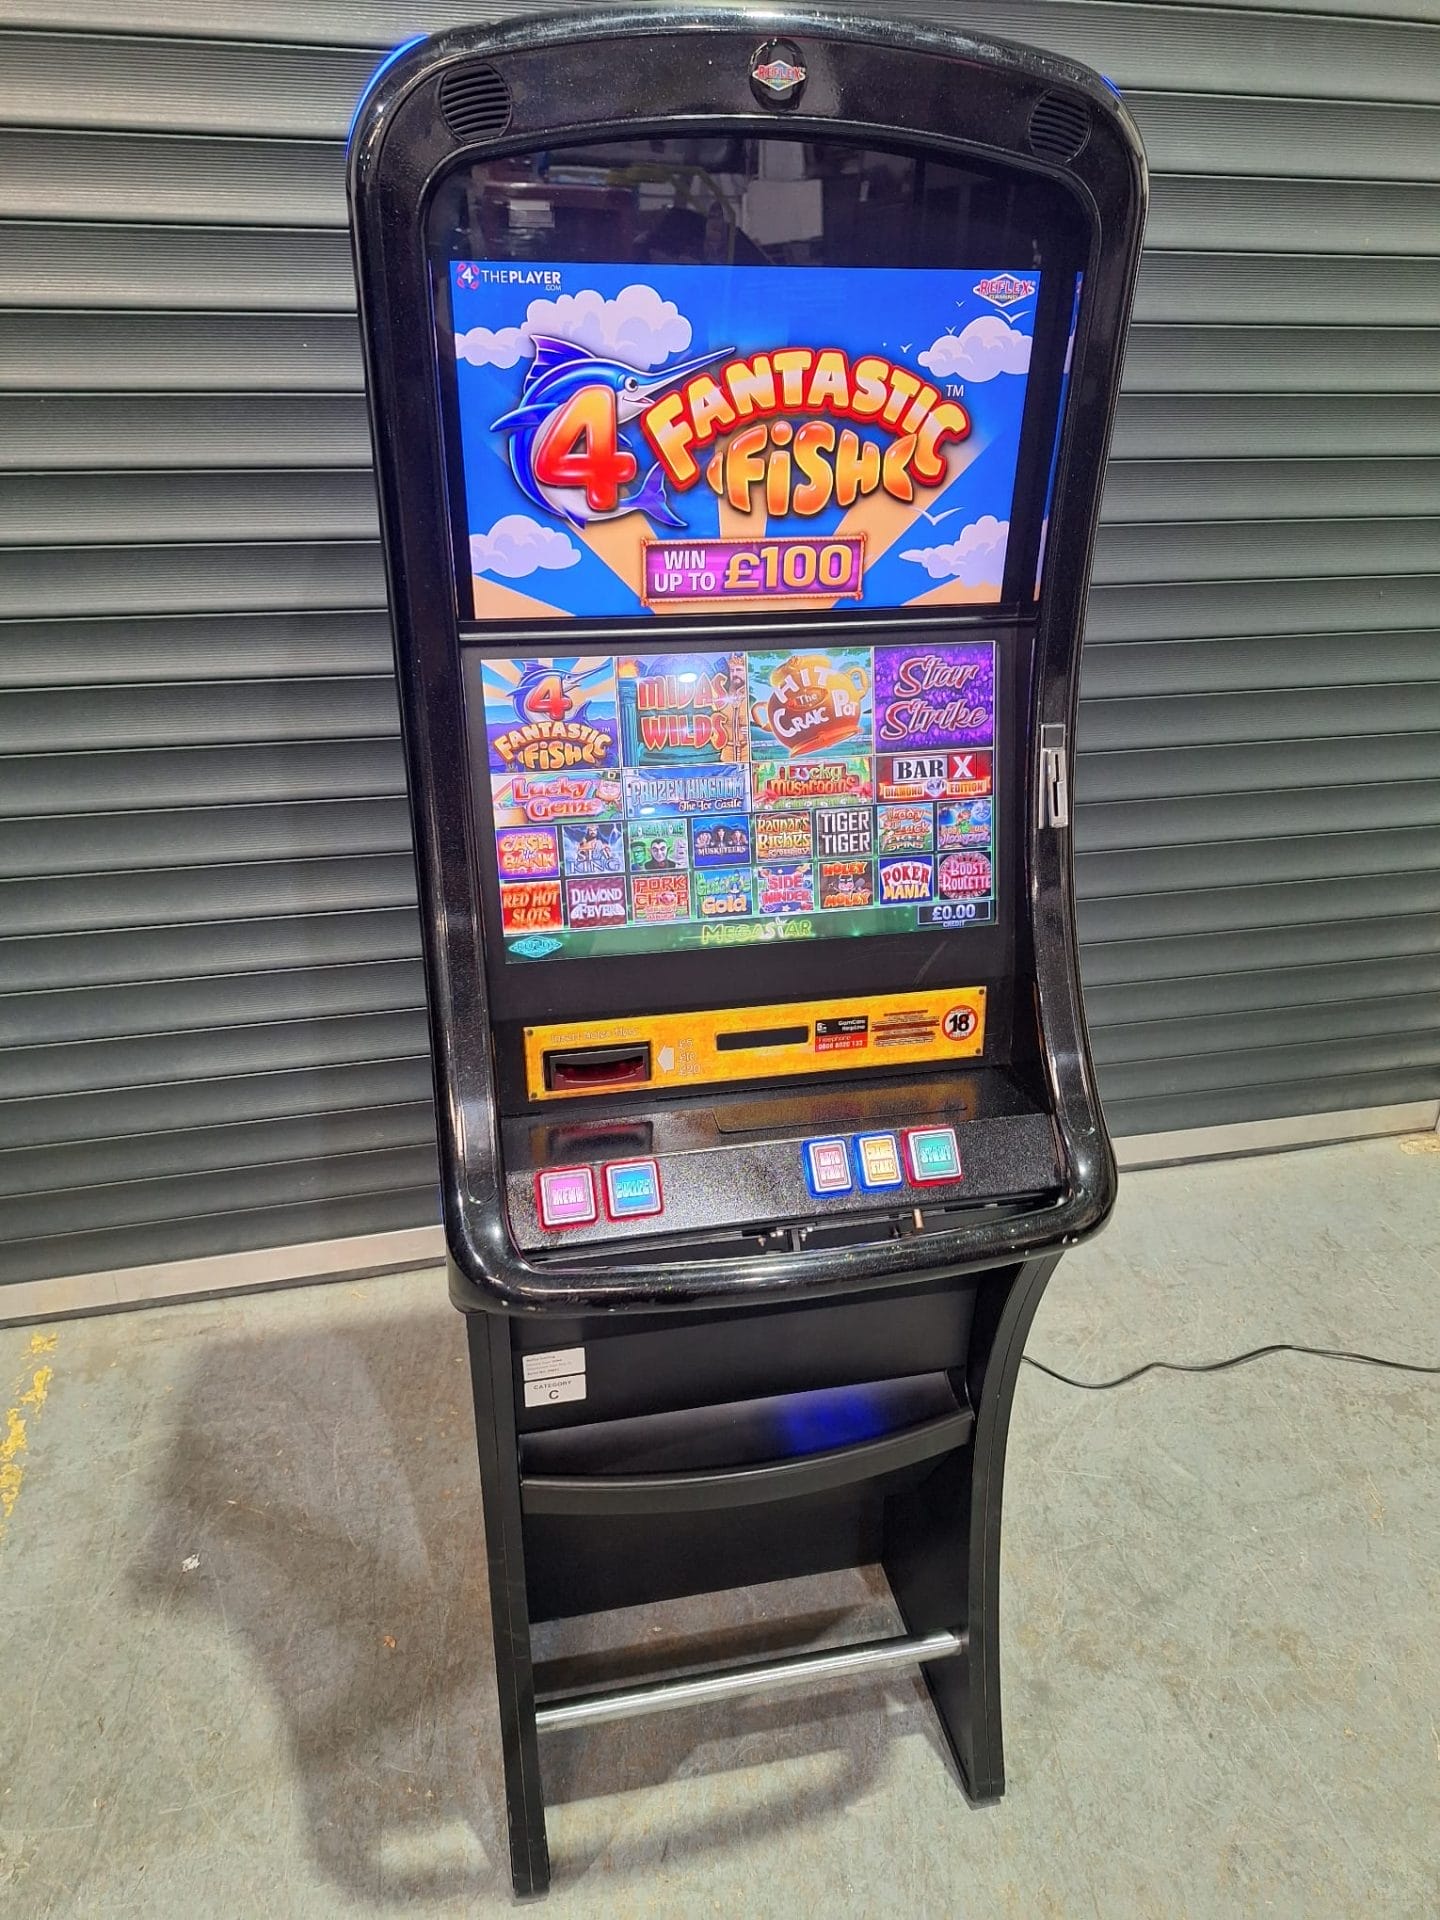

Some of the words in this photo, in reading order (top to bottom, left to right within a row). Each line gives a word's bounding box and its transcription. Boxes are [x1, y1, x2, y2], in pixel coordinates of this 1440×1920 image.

[980, 279, 1030, 296] REFLEX
[536, 386, 637, 511] 4
[641, 348, 970, 490] FANTASTIC
[663, 549, 707, 571] WIN
[725, 544, 854, 592] £100
[654, 573, 683, 593] UP
[686, 571, 716, 592] TO
[775, 667, 827, 703] HIT
[894, 654, 980, 698] Star
[527, 675, 572, 721] 4
[637, 672, 728, 711] MIDAS
[798, 691, 818, 705] The
[880, 699, 989, 741] Strike
[641, 713, 728, 751] WILDS
[493, 721, 613, 762] FANTASTIC
[897, 760, 944, 779] BAR
[953, 755, 973, 778] X
[512, 776, 591, 801] Lucky
[632, 779, 684, 802] FROZEN
[686, 776, 744, 800] KINGDOM
[885, 785, 924, 797] DIAMOND
[950, 781, 984, 793] EDITION
[528, 799, 603, 819] Gems
[679, 800, 696, 812] The
[714, 799, 742, 811] Castle
[821, 811, 870, 833] TIGER
[501, 835, 553, 852] CASH
[822, 831, 871, 854] TIGER
[503, 853, 555, 869] BANK
[570, 859, 621, 873] KING
[822, 861, 868, 877] HOLEY
[951, 860, 985, 876] BOOST
[635, 875, 687, 892] PORK
[768, 874, 805, 891] SIDE
[882, 864, 930, 887] POKER
[942, 872, 991, 891] ROULETTE
[504, 892, 528, 907] RED
[531, 890, 558, 906] HOT
[571, 886, 622, 905] DIAMOND
[761, 890, 811, 904] WINDER
[823, 892, 871, 907] MOLEY
[884, 884, 931, 900] MANIA
[512, 906, 551, 923] SLOTS
[578, 902, 619, 920] FEVER
[932, 903, 976, 921] £0.00
[943, 920, 965, 928] CREDIT
[949, 1013, 971, 1033] 18
[533, 1380, 573, 1391] CATEGORY
[548, 1389, 560, 1400] C
